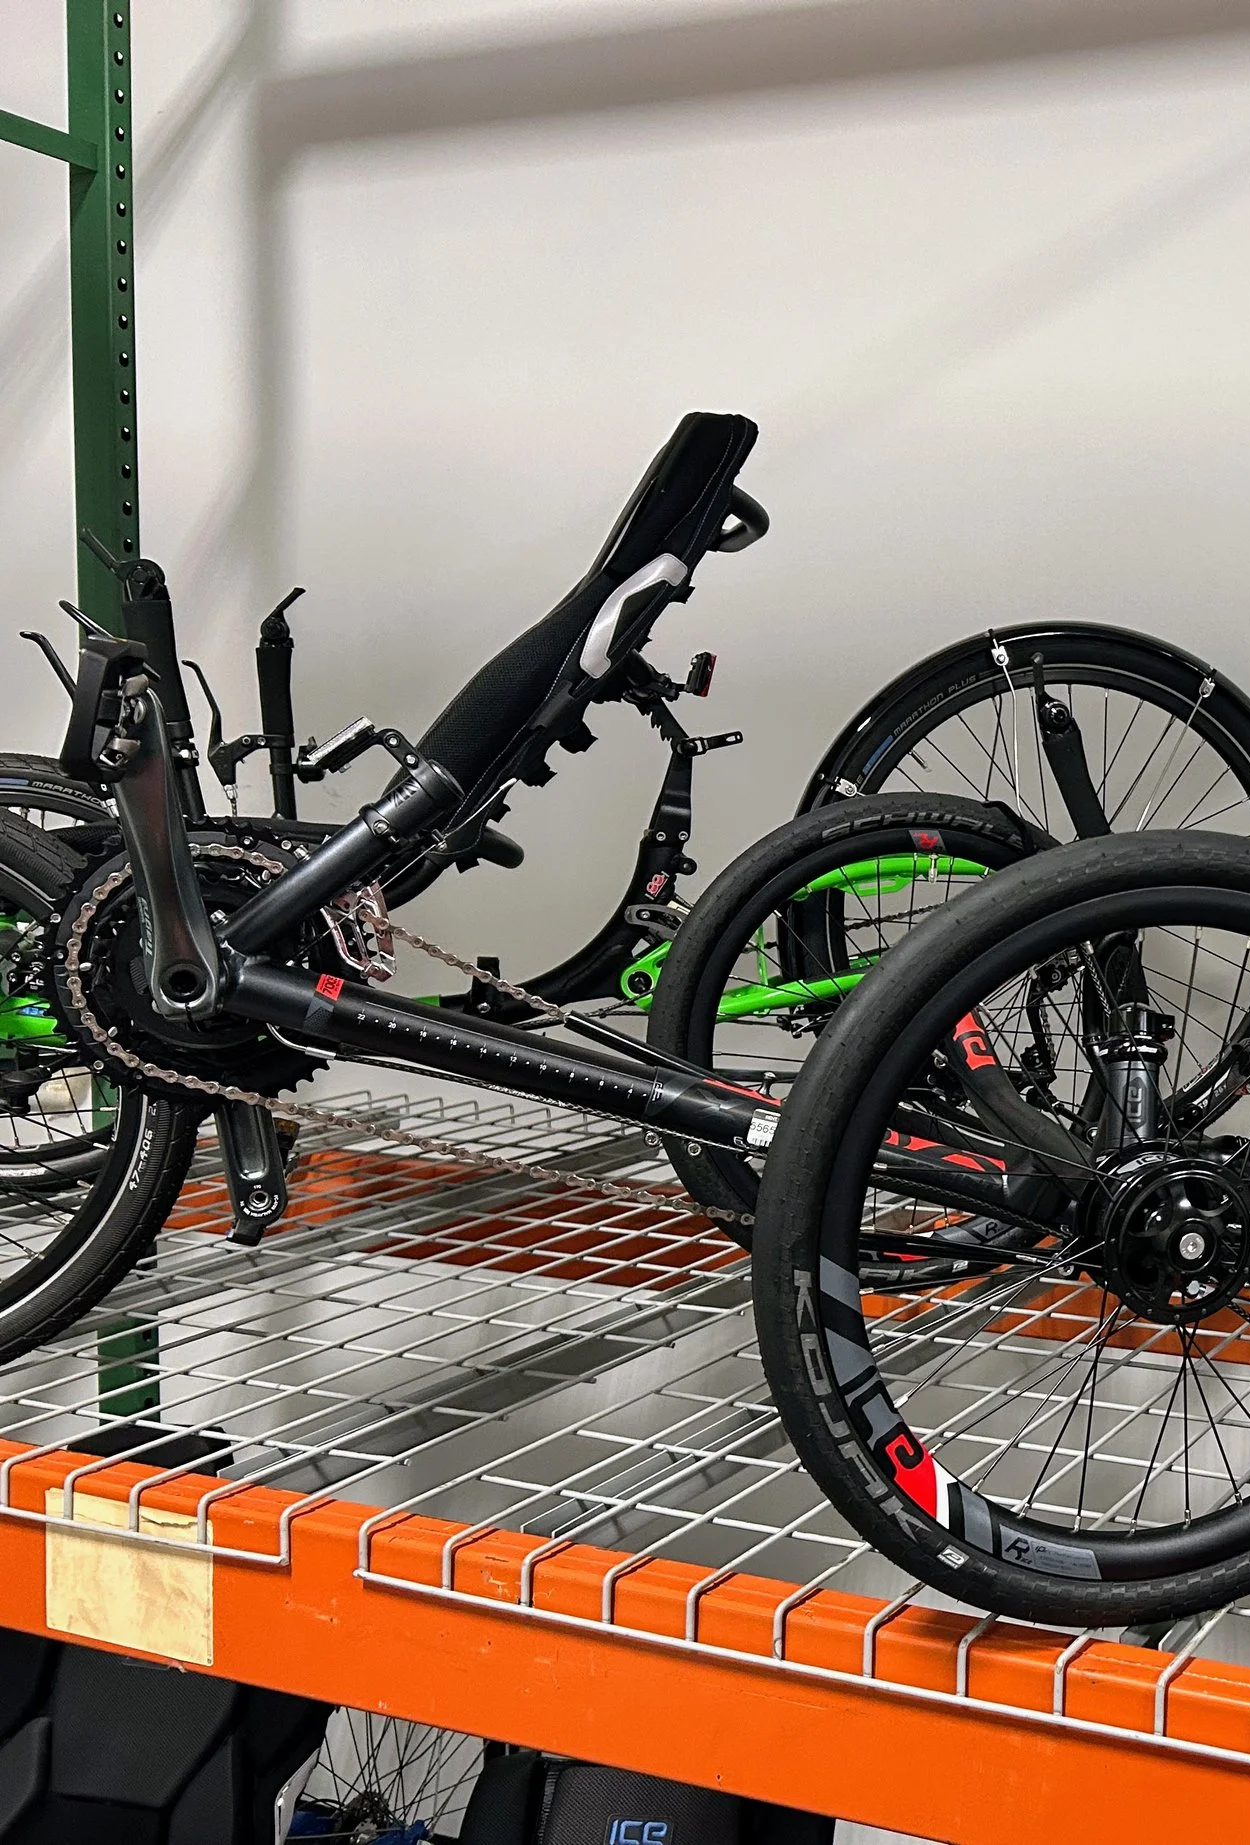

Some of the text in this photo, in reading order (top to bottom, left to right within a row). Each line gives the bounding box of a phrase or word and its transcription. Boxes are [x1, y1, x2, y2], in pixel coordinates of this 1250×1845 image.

[893, 673, 977, 737] MARATHON PLUS
[32, 780, 101, 805] MARATHO
[821, 811, 1026, 850] SCHWALB
[356, 1013, 366, 1021] 22
[510, 1055, 517, 1063] 12
[793, 1269, 932, 1543] KOJAK
